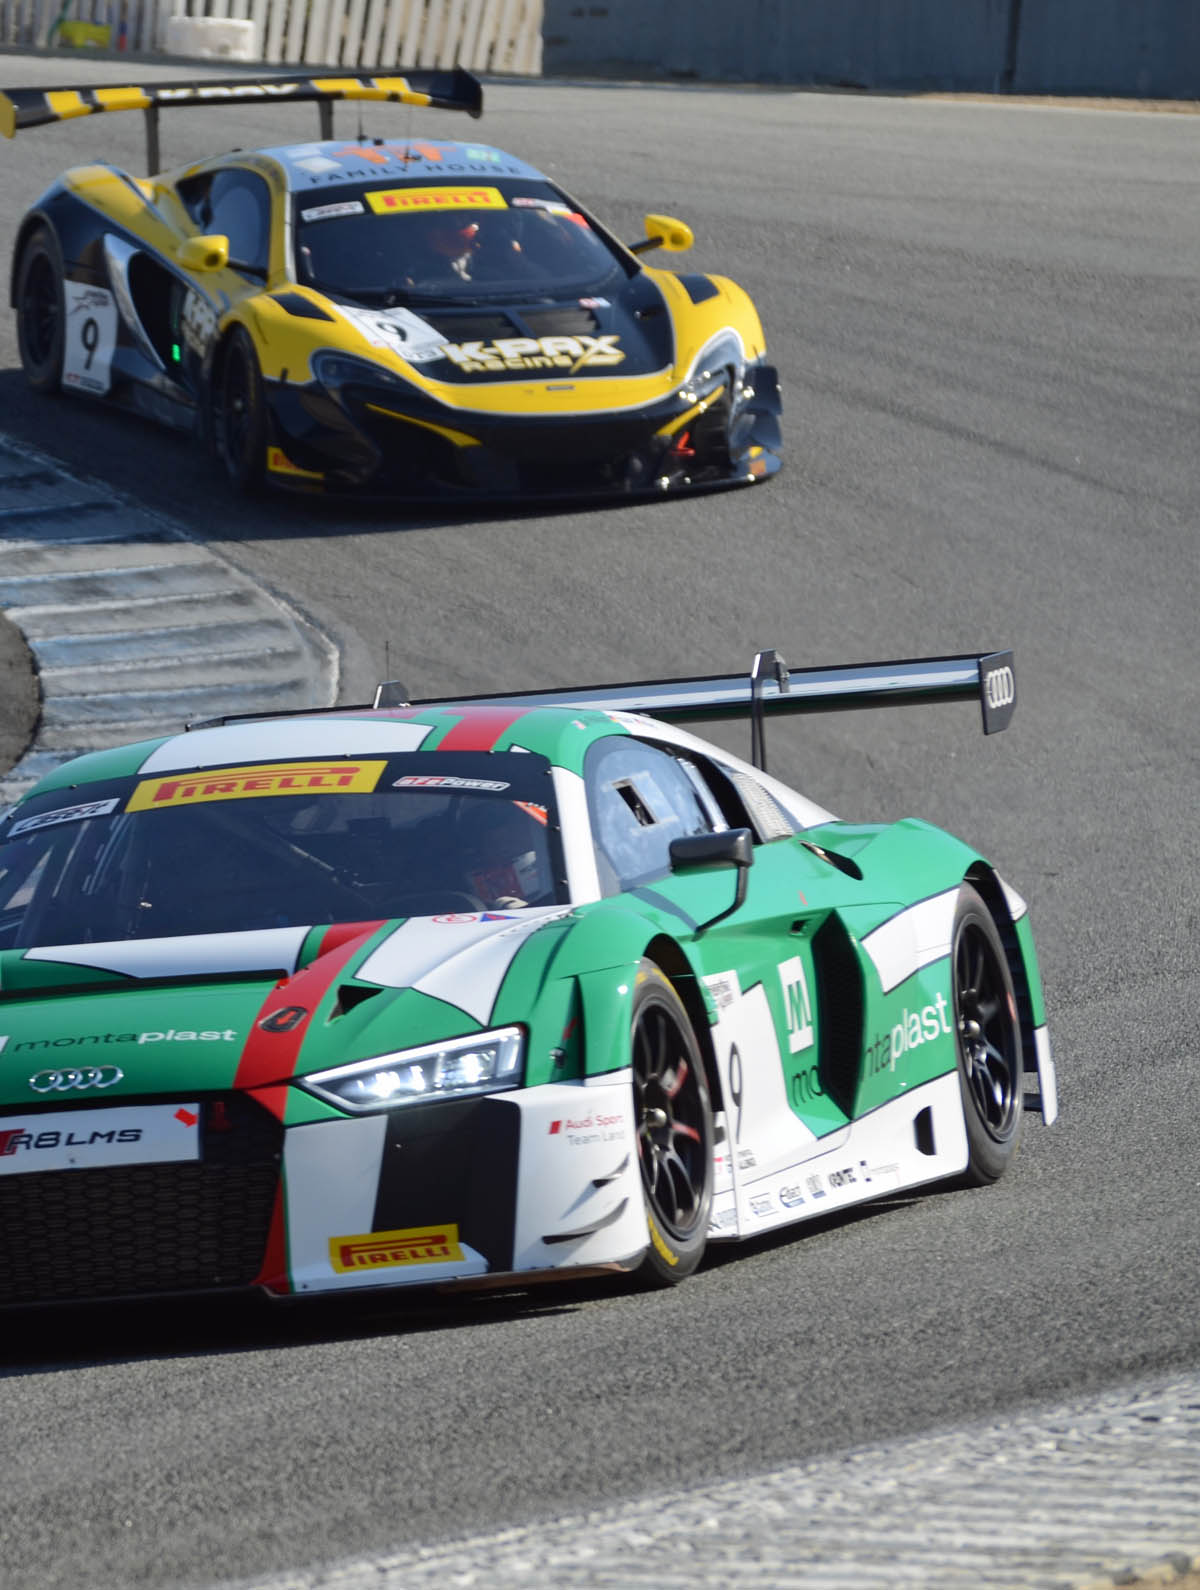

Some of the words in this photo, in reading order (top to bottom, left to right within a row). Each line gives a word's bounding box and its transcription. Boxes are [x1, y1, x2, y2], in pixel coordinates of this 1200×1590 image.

[309, 165, 408, 184] FAMILY
[424, 163, 521, 175] HOUSE
[383, 191, 491, 208] PIRELLI
[81, 316, 100, 371] 9
[376, 321, 408, 342] 9
[441, 335, 623, 368] K-PAX
[152, 766, 361, 802] PIRELLI
[13, 1029, 238, 1052] montaplast
[5, 1131, 61, 1152] R8
[65, 1128, 143, 1147] LMS
[339, 1234, 451, 1268] PIRELLI
